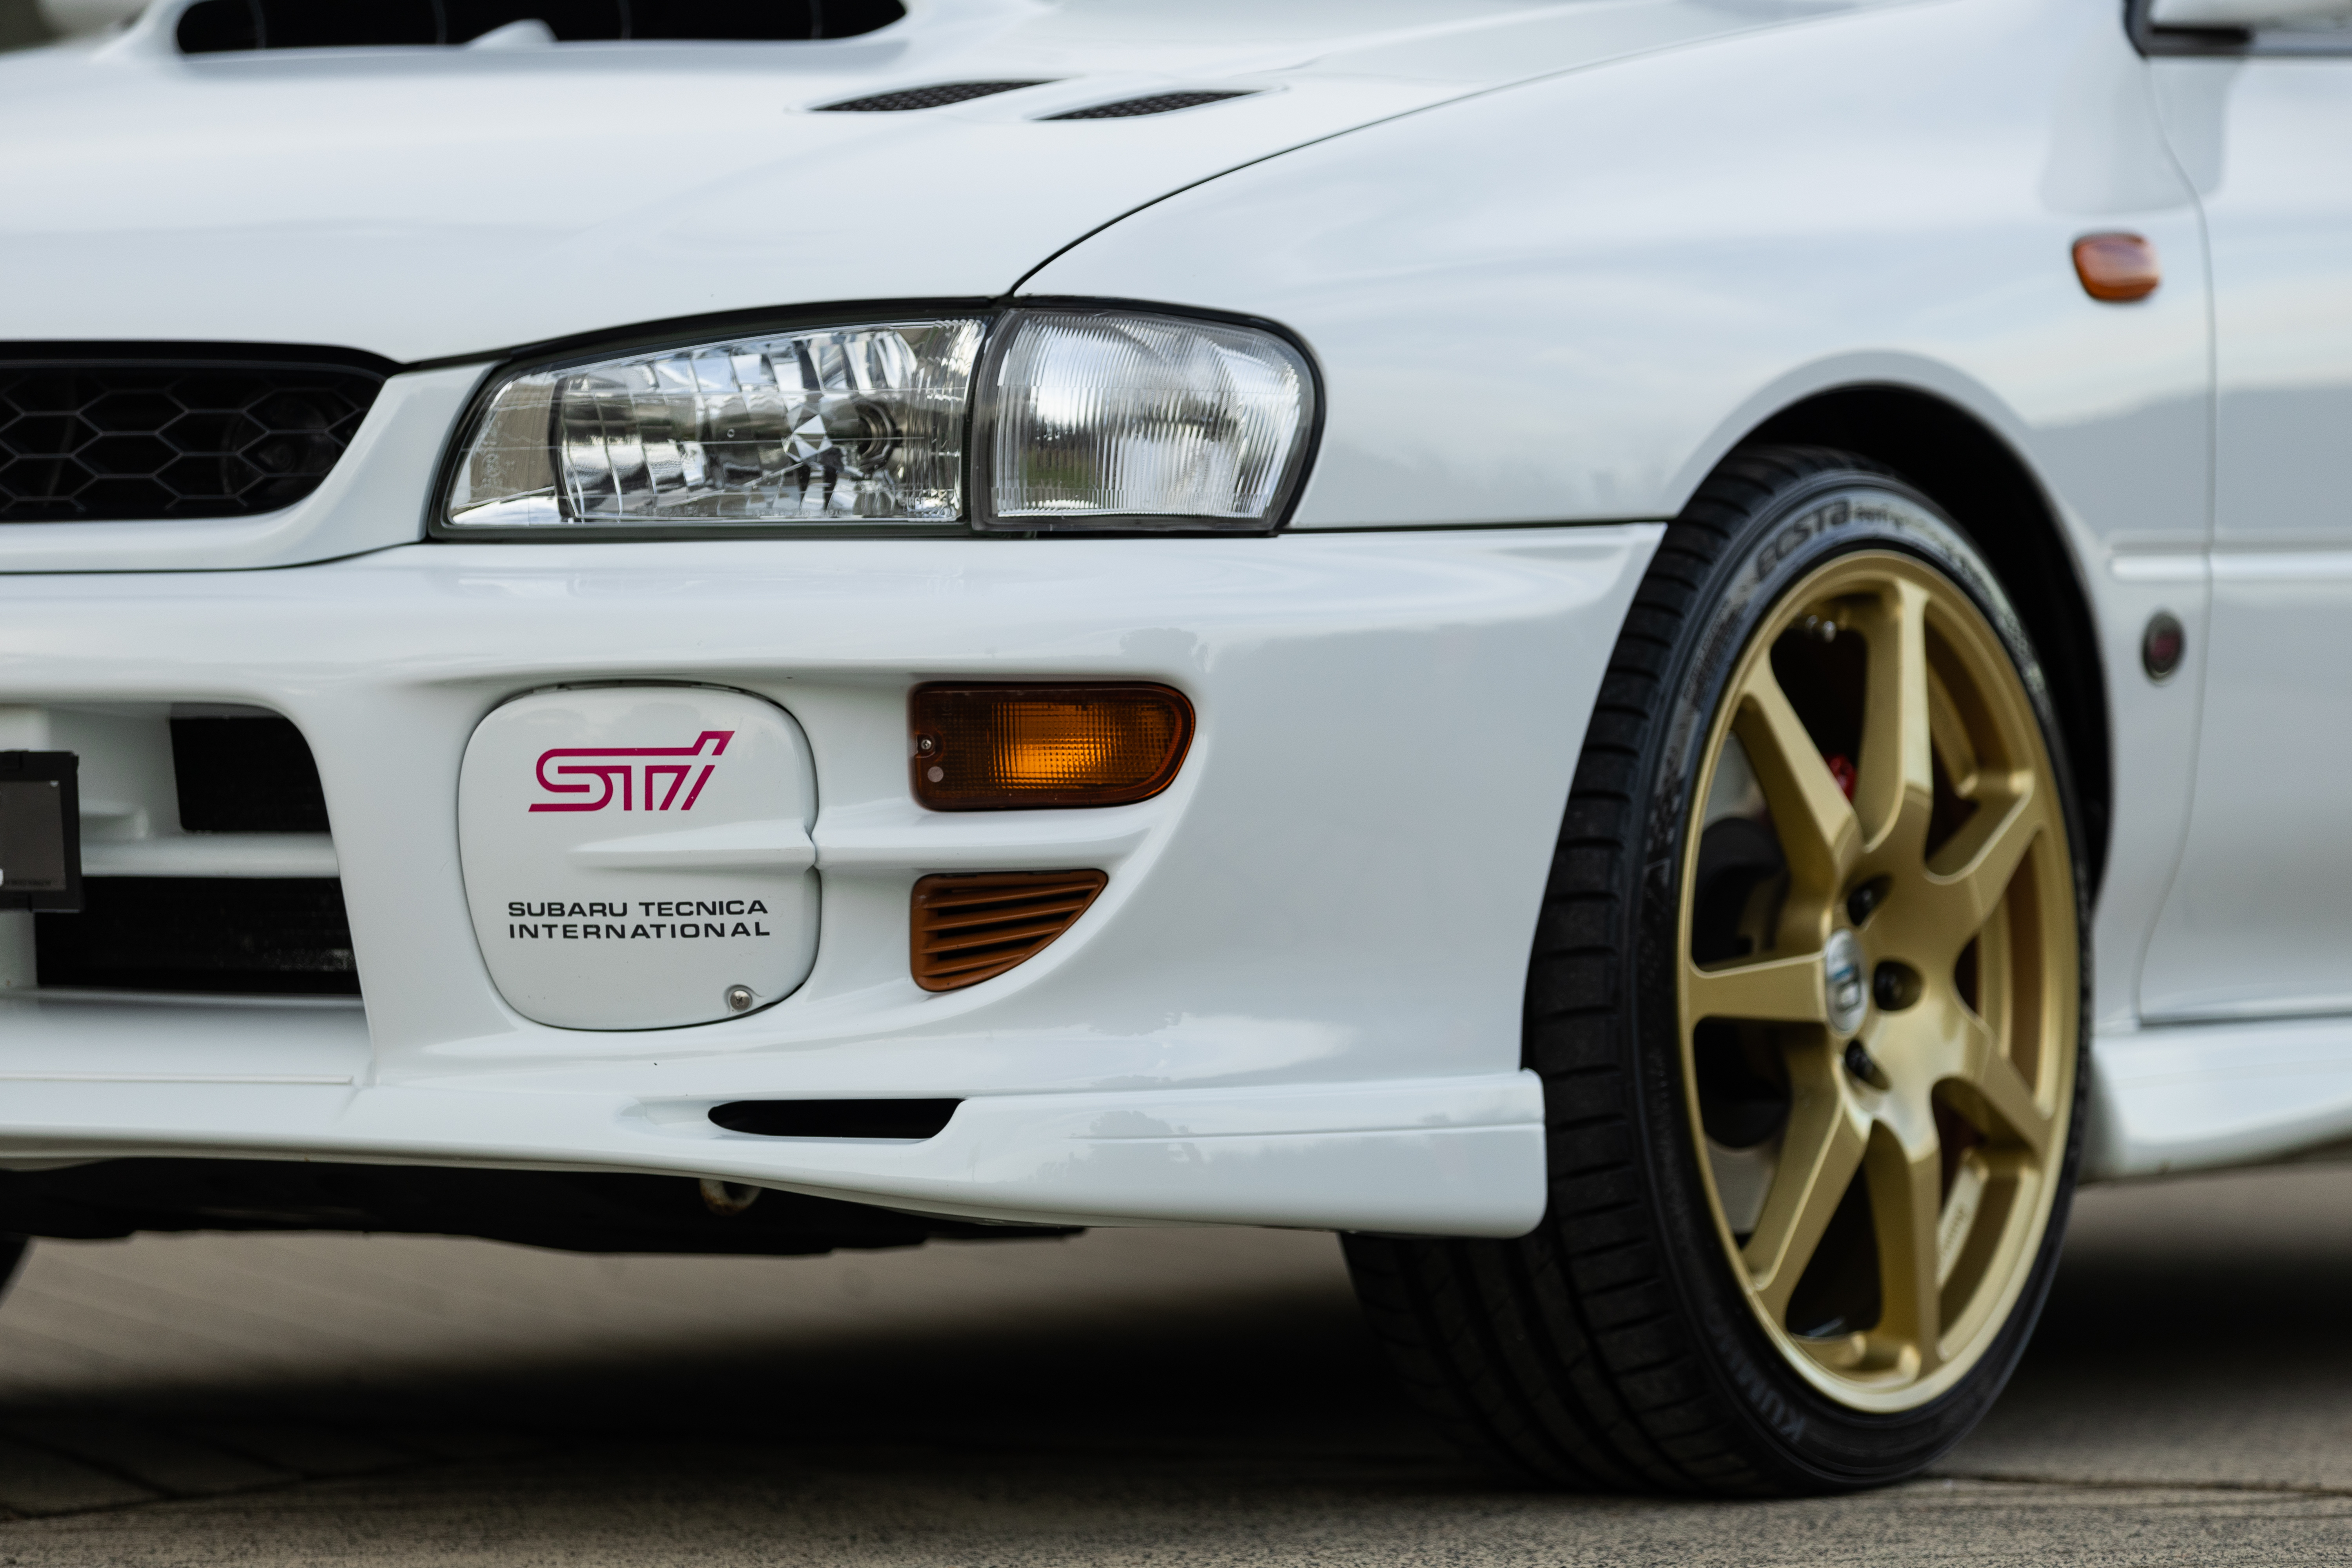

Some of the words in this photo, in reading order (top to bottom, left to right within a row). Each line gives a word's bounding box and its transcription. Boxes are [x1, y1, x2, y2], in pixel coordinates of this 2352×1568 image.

[508, 902, 628, 917] SUBARU
[639, 900, 768, 917] TECNICA
[509, 921, 770, 939] INTERNATIONAL
